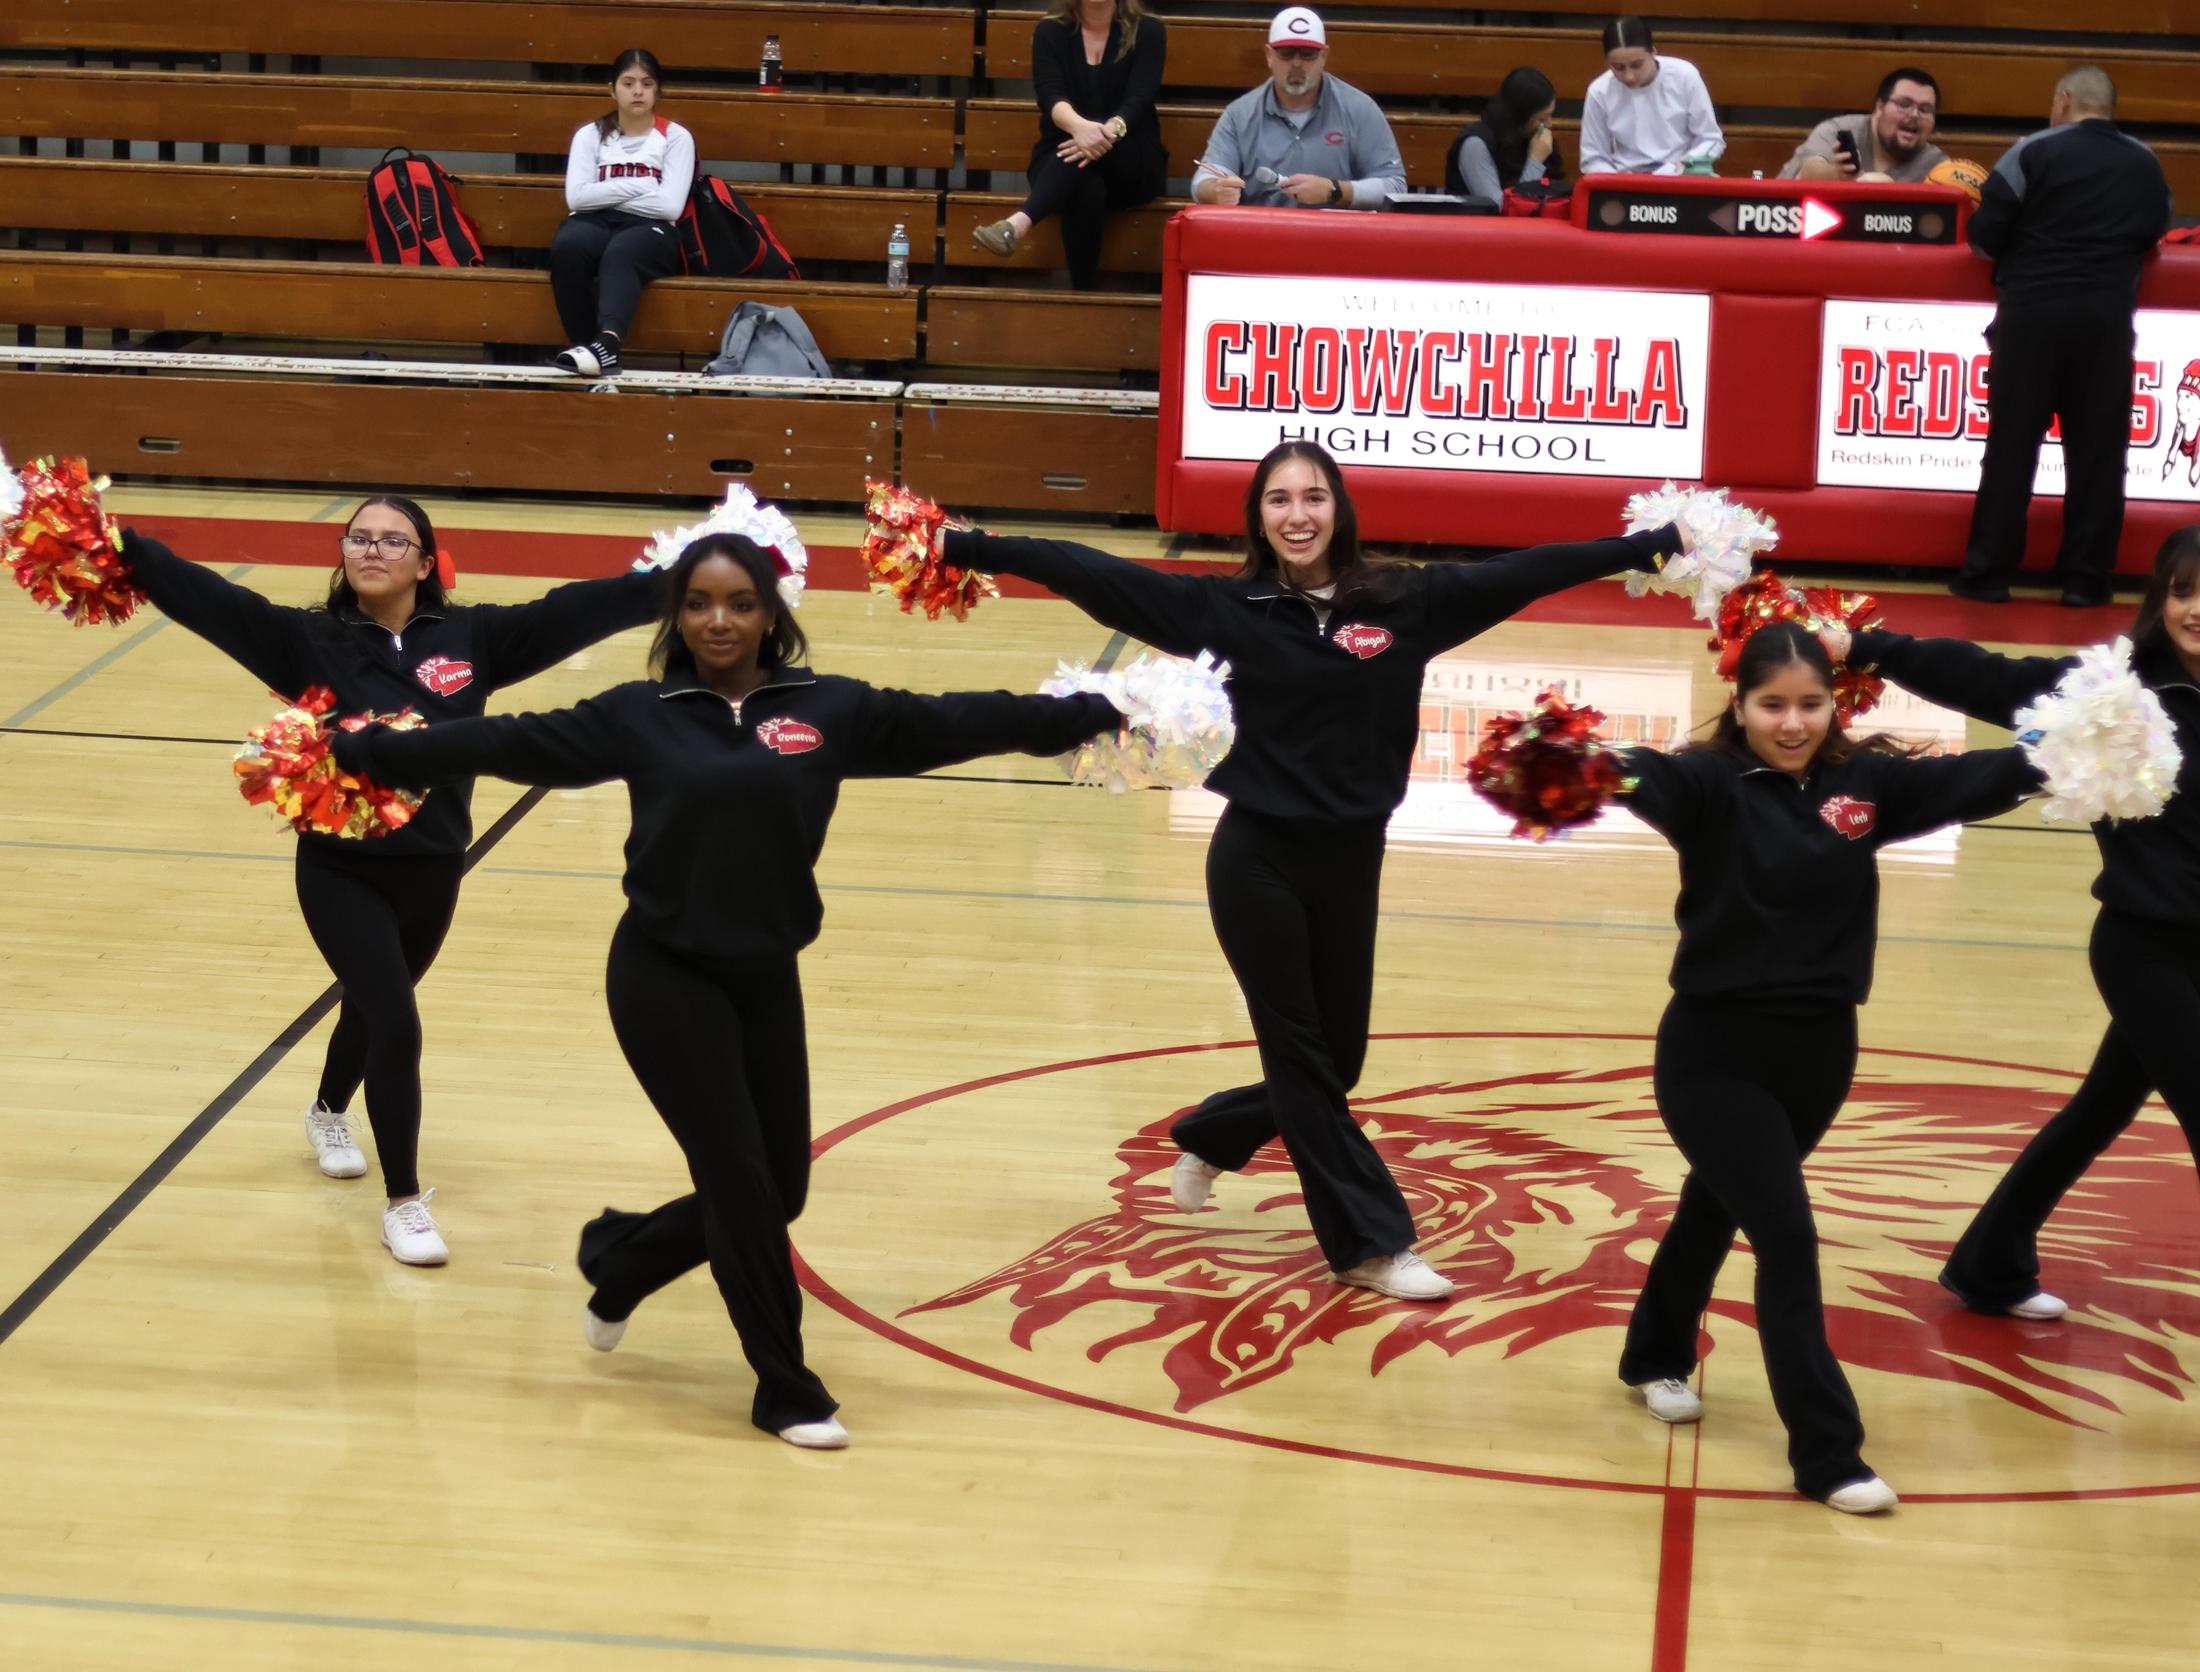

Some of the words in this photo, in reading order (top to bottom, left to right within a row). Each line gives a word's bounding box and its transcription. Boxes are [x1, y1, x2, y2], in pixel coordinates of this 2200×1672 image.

[1288, 18, 1311, 34] C
[1324, 130, 1345, 145] C
[1629, 204, 1678, 224] BONUS
[1737, 204, 1803, 234] POSS
[1864, 214, 1913, 233] BONUS
[1202, 319, 1689, 429] CHOWCHILLA
[1279, 425, 1390, 453] HIGH
[1411, 430, 1606, 462] SCHOOL
[1831, 449, 1912, 466] Redskin
[1919, 453, 1971, 469] Pride
[1354, 632, 1387, 649] Abigail
